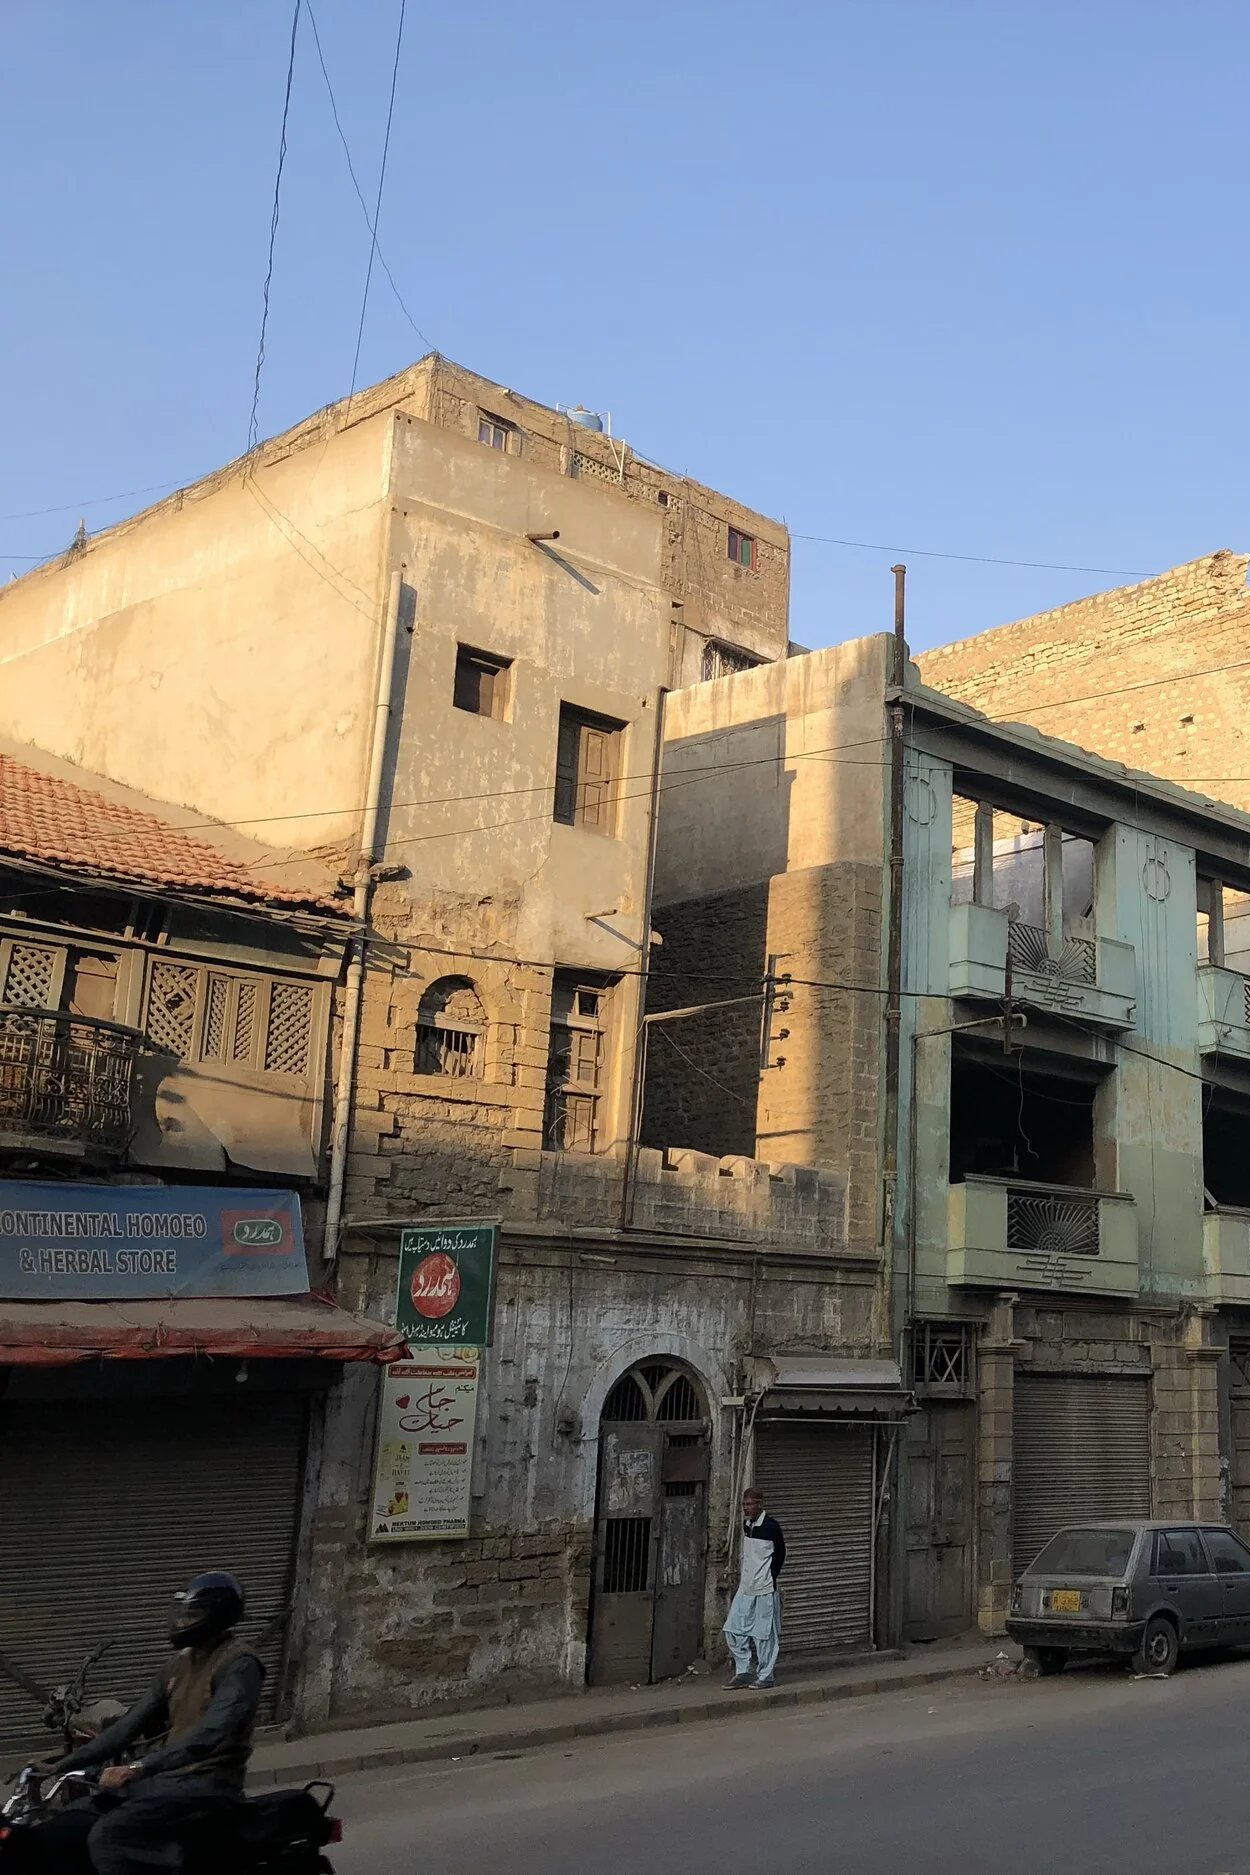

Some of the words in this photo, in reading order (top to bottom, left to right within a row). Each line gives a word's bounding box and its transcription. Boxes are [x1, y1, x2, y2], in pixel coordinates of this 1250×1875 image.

[0, 1210, 123, 1237] ONTINENTAL
[126, 1212, 207, 1238] HOMOEO
[241, 1224, 275, 1240] ہمدرد
[457, 1235, 478, 1249] ہمدرد
[19, 1247, 37, 1274] &
[39, 1248, 114, 1275] HERBAL
[116, 1249, 177, 1275] STORE
[413, 1267, 456, 1297] ہمدرد
[416, 1383, 457, 1414] جام
[399, 1409, 465, 1434] حیات
